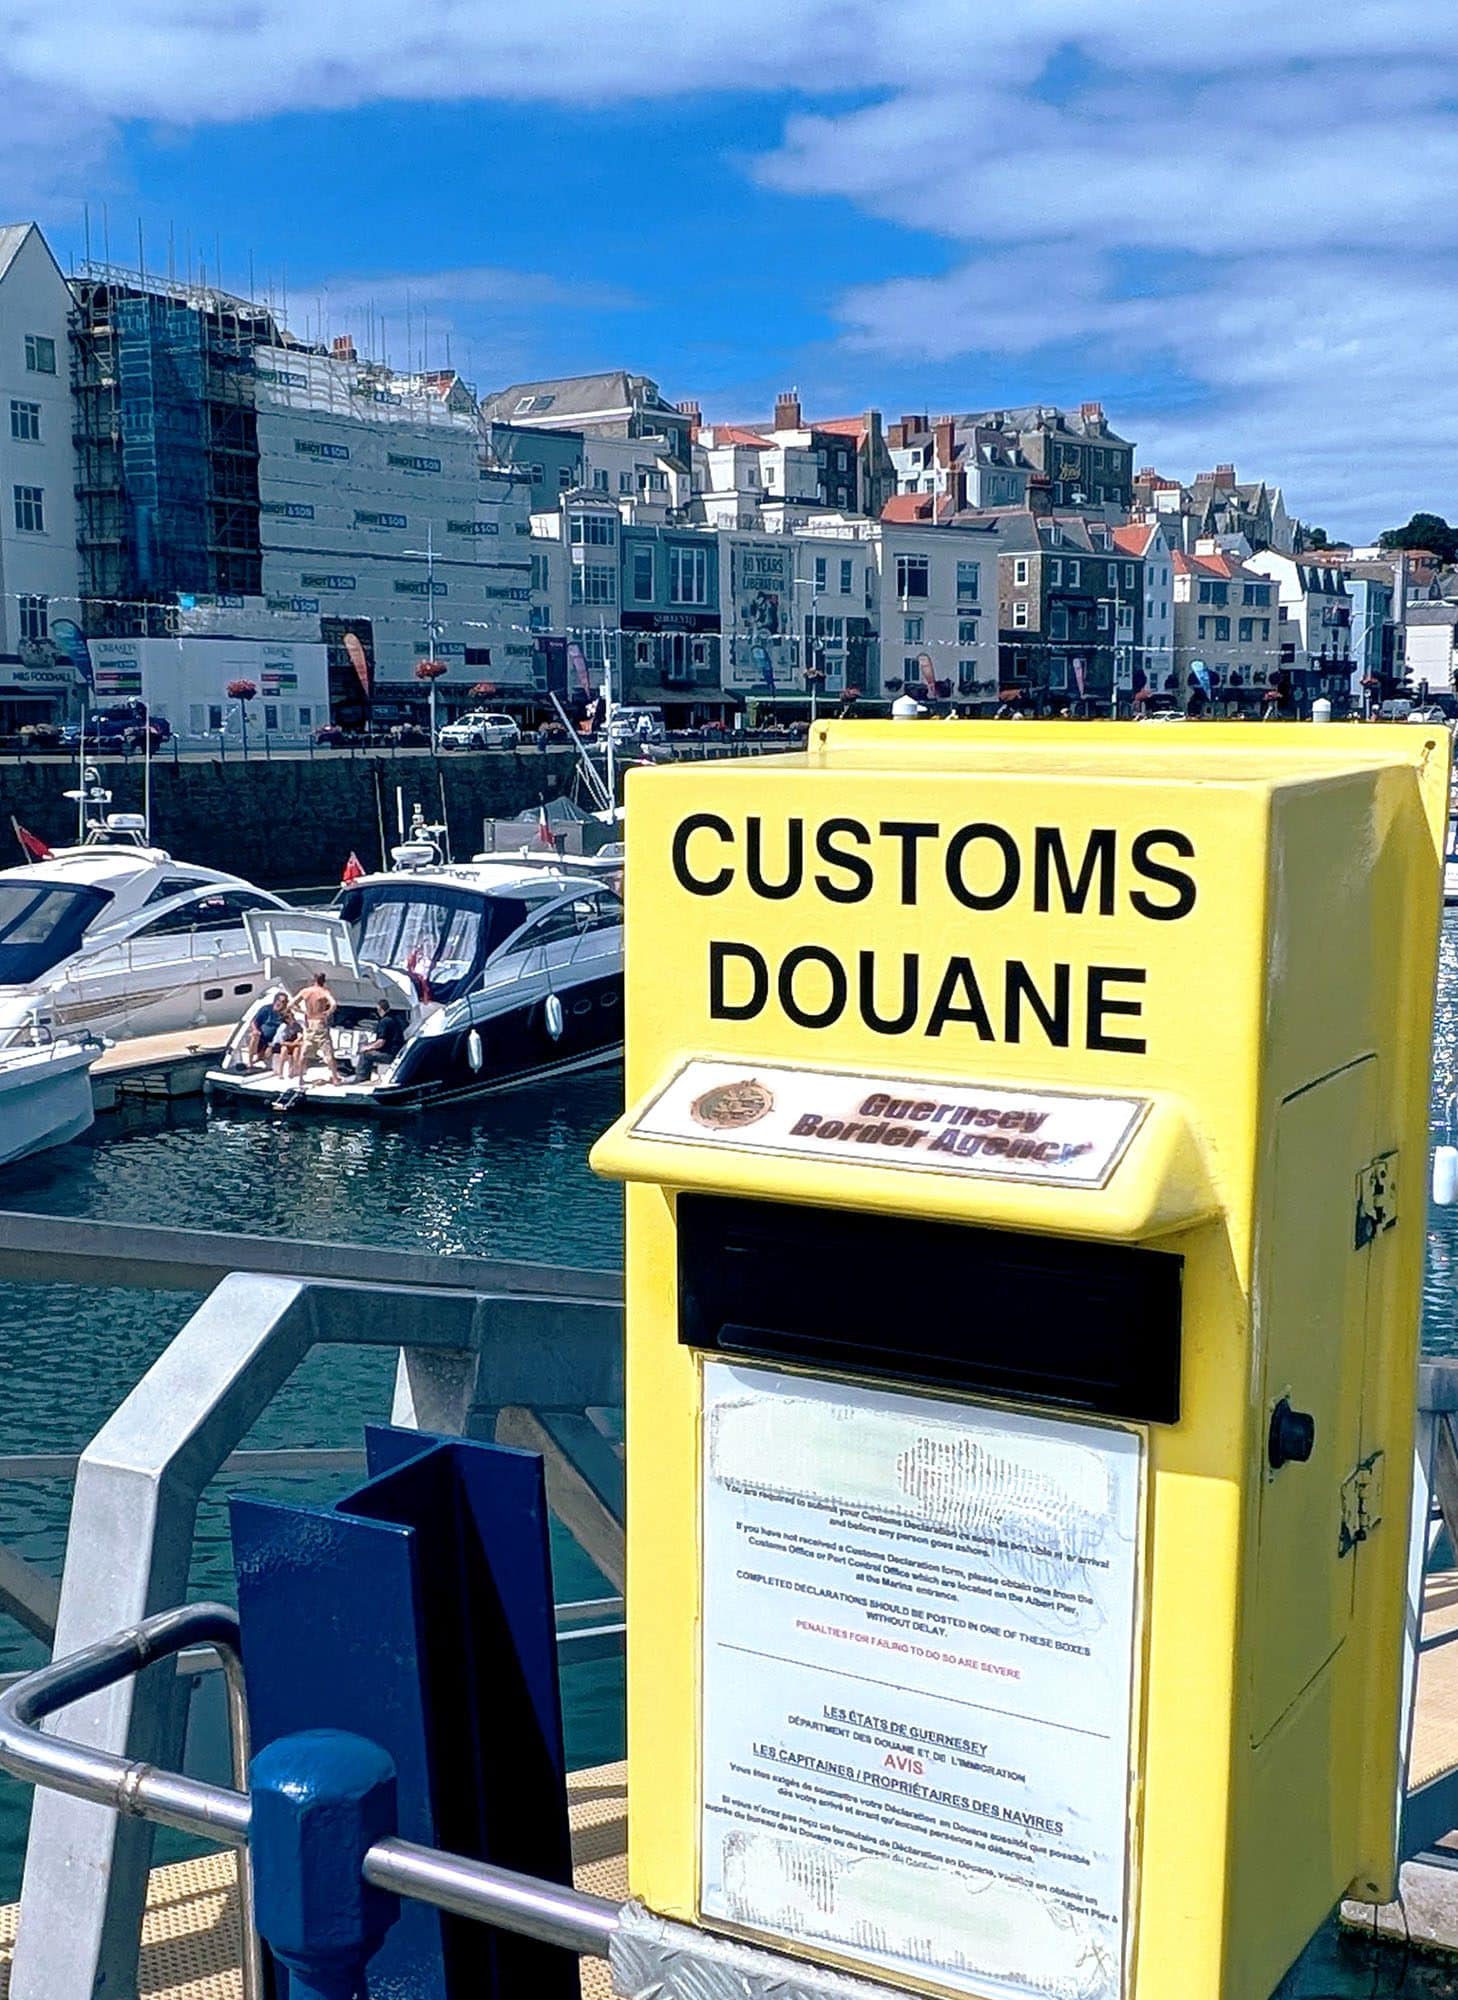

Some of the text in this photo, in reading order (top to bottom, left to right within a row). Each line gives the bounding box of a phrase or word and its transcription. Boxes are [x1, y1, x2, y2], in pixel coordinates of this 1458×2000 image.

[756, 557, 784, 574] YEARS
[672, 812, 1197, 922] CUSTOMS
[709, 939, 1147, 1055] DOUANE
[860, 1092, 1052, 1135] Guernsey
[790, 1112, 1094, 1168] Border Agency
[839, 1508, 858, 1517] your
[861, 1510, 901, 1526] Customs
[848, 1521, 876, 1533] before
[897, 1533, 928, 1544] person
[930, 1539, 952, 1549] goes
[748, 1535, 786, 1551] Customs
[788, 1544, 813, 1557] Office
[847, 1557, 880, 1571] Control
[883, 1564, 909, 1578] Office
[912, 1572, 938, 1584] which
[958, 1581, 992, 1595] located
[1025, 1595, 1054, 1609] Albert
[761, 1526, 780, 1538] have
[799, 1536, 836, 1550] received
[845, 1544, 884, 1560] Customs
[887, 1553, 939, 1572] Declaration
[968, 1571, 998, 1584] please
[1053, 1588, 1075, 1600] from
[882, 1578, 912, 1591] Marina
[736, 1569, 1090, 1656] COMPLETED DECLARATIONS SHOULD BE POSTED IN ONE OF THESE BOXES
[866, 1611, 947, 1637] WITHOUT DELAY.
[796, 1619, 1020, 1679] PENALTIES FOR FAILING TO DO SO ARE SEVERE
[824, 1705, 846, 1720] LES
[890, 1721, 906, 1735] DE
[909, 1726, 987, 1755] GUERNESEY
[853, 1731, 871, 1744] DES
[874, 1737, 915, 1755] DOUANE
[918, 1748, 929, 1758] ET
[933, 1752, 945, 1762] DE
[753, 1742, 1063, 1833] LES CAPITAINES / PROPRIÉTAIRES DES NAVIRES
[884, 1753, 923, 1775] AVIS
[730, 1762, 750, 1775] Vous
[860, 1799, 881, 1810] votre
[953, 1822, 987, 1838] Douane
[1049, 1849, 1089, 1865] possible
[732, 1799, 750, 1810] vous
[795, 1793, 815, 1804] votre
[929, 1829, 972, 1846] personne
[799, 1827, 831, 1843] Douane
